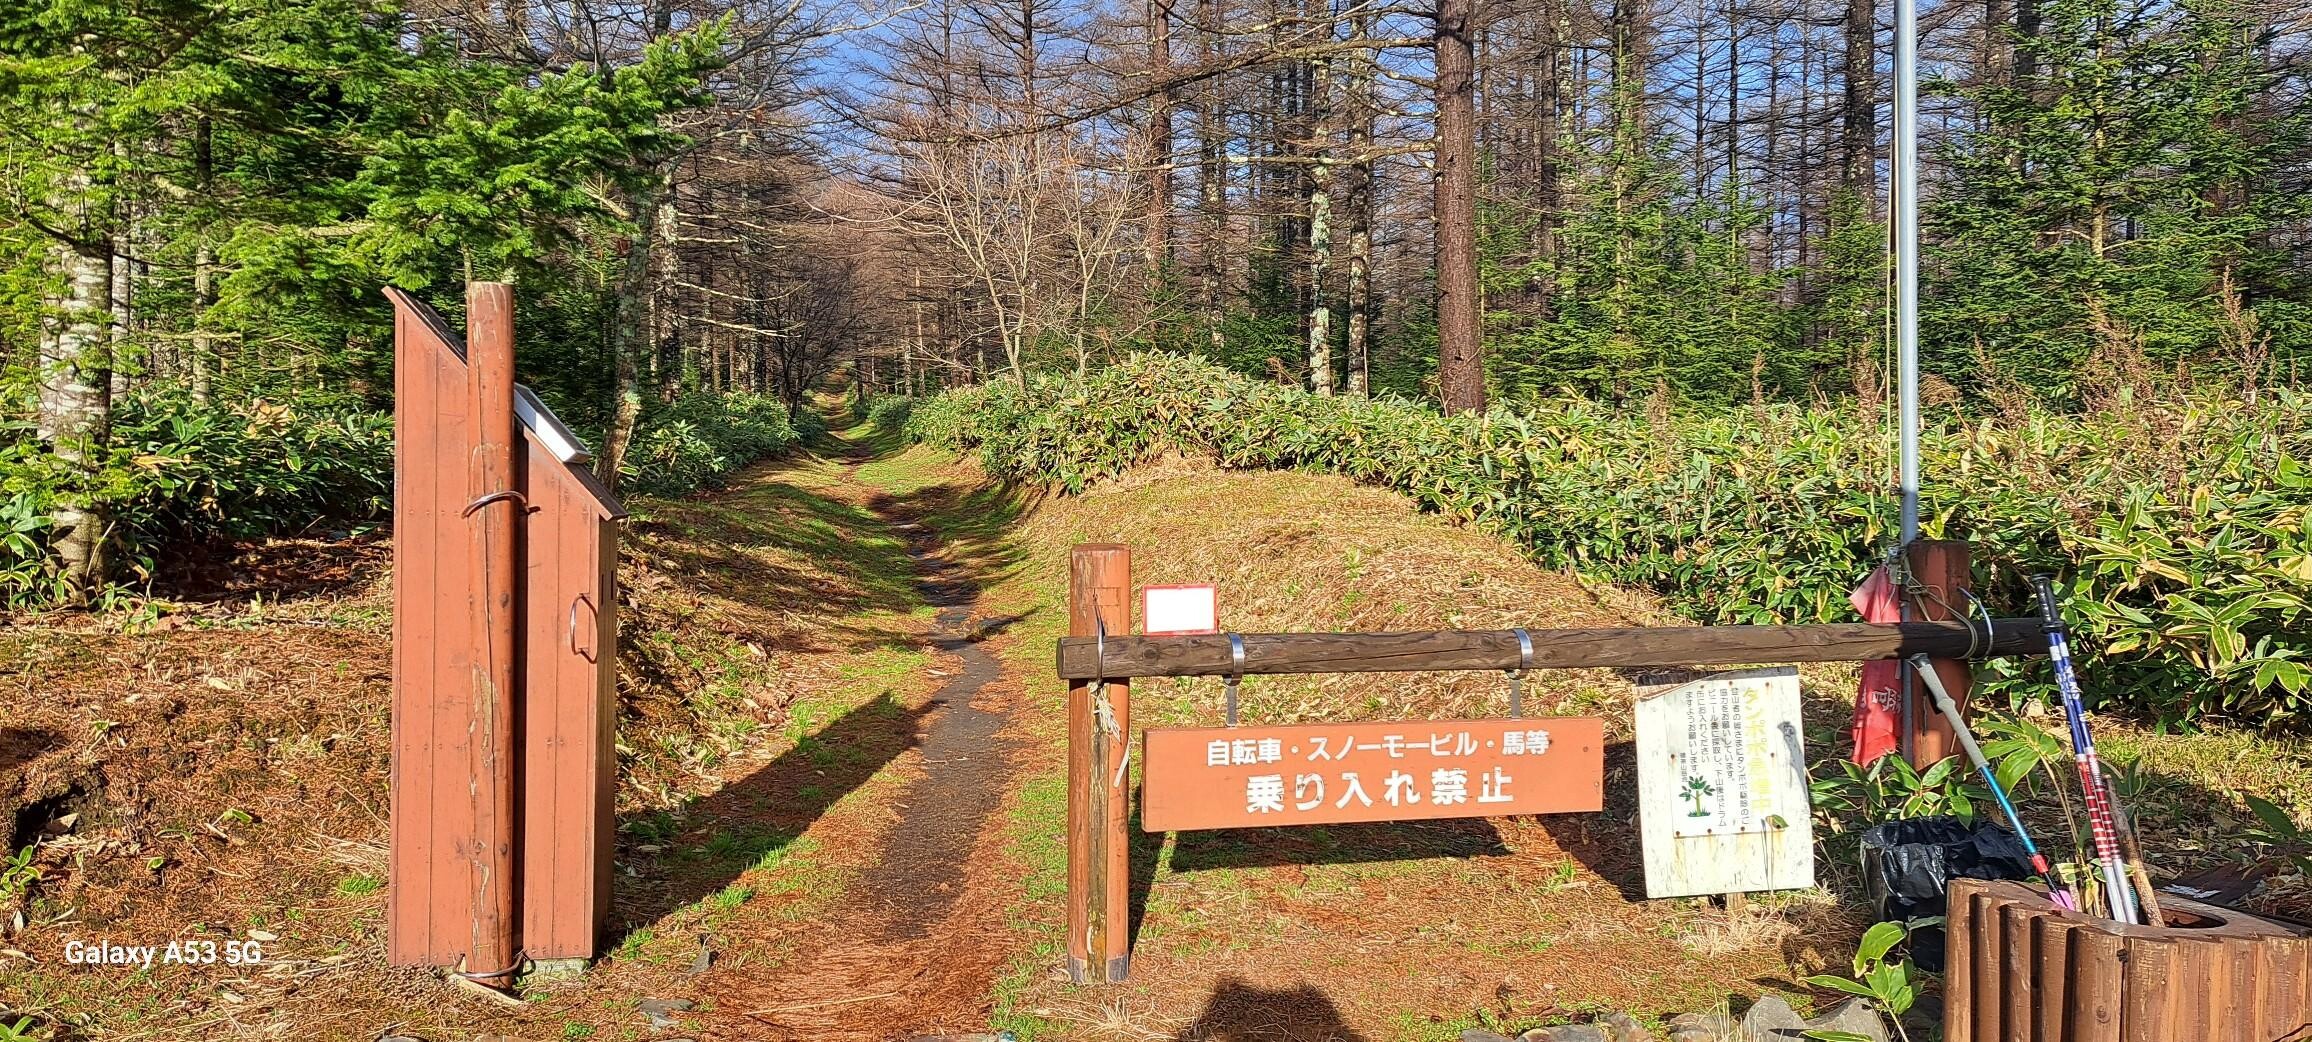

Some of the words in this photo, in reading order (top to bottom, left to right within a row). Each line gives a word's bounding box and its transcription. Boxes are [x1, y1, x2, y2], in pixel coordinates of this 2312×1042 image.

[1206, 730, 1550, 766] 自転車・スノーモービル・馬等
[1245, 766, 1514, 814] 乗り入れ禁止
